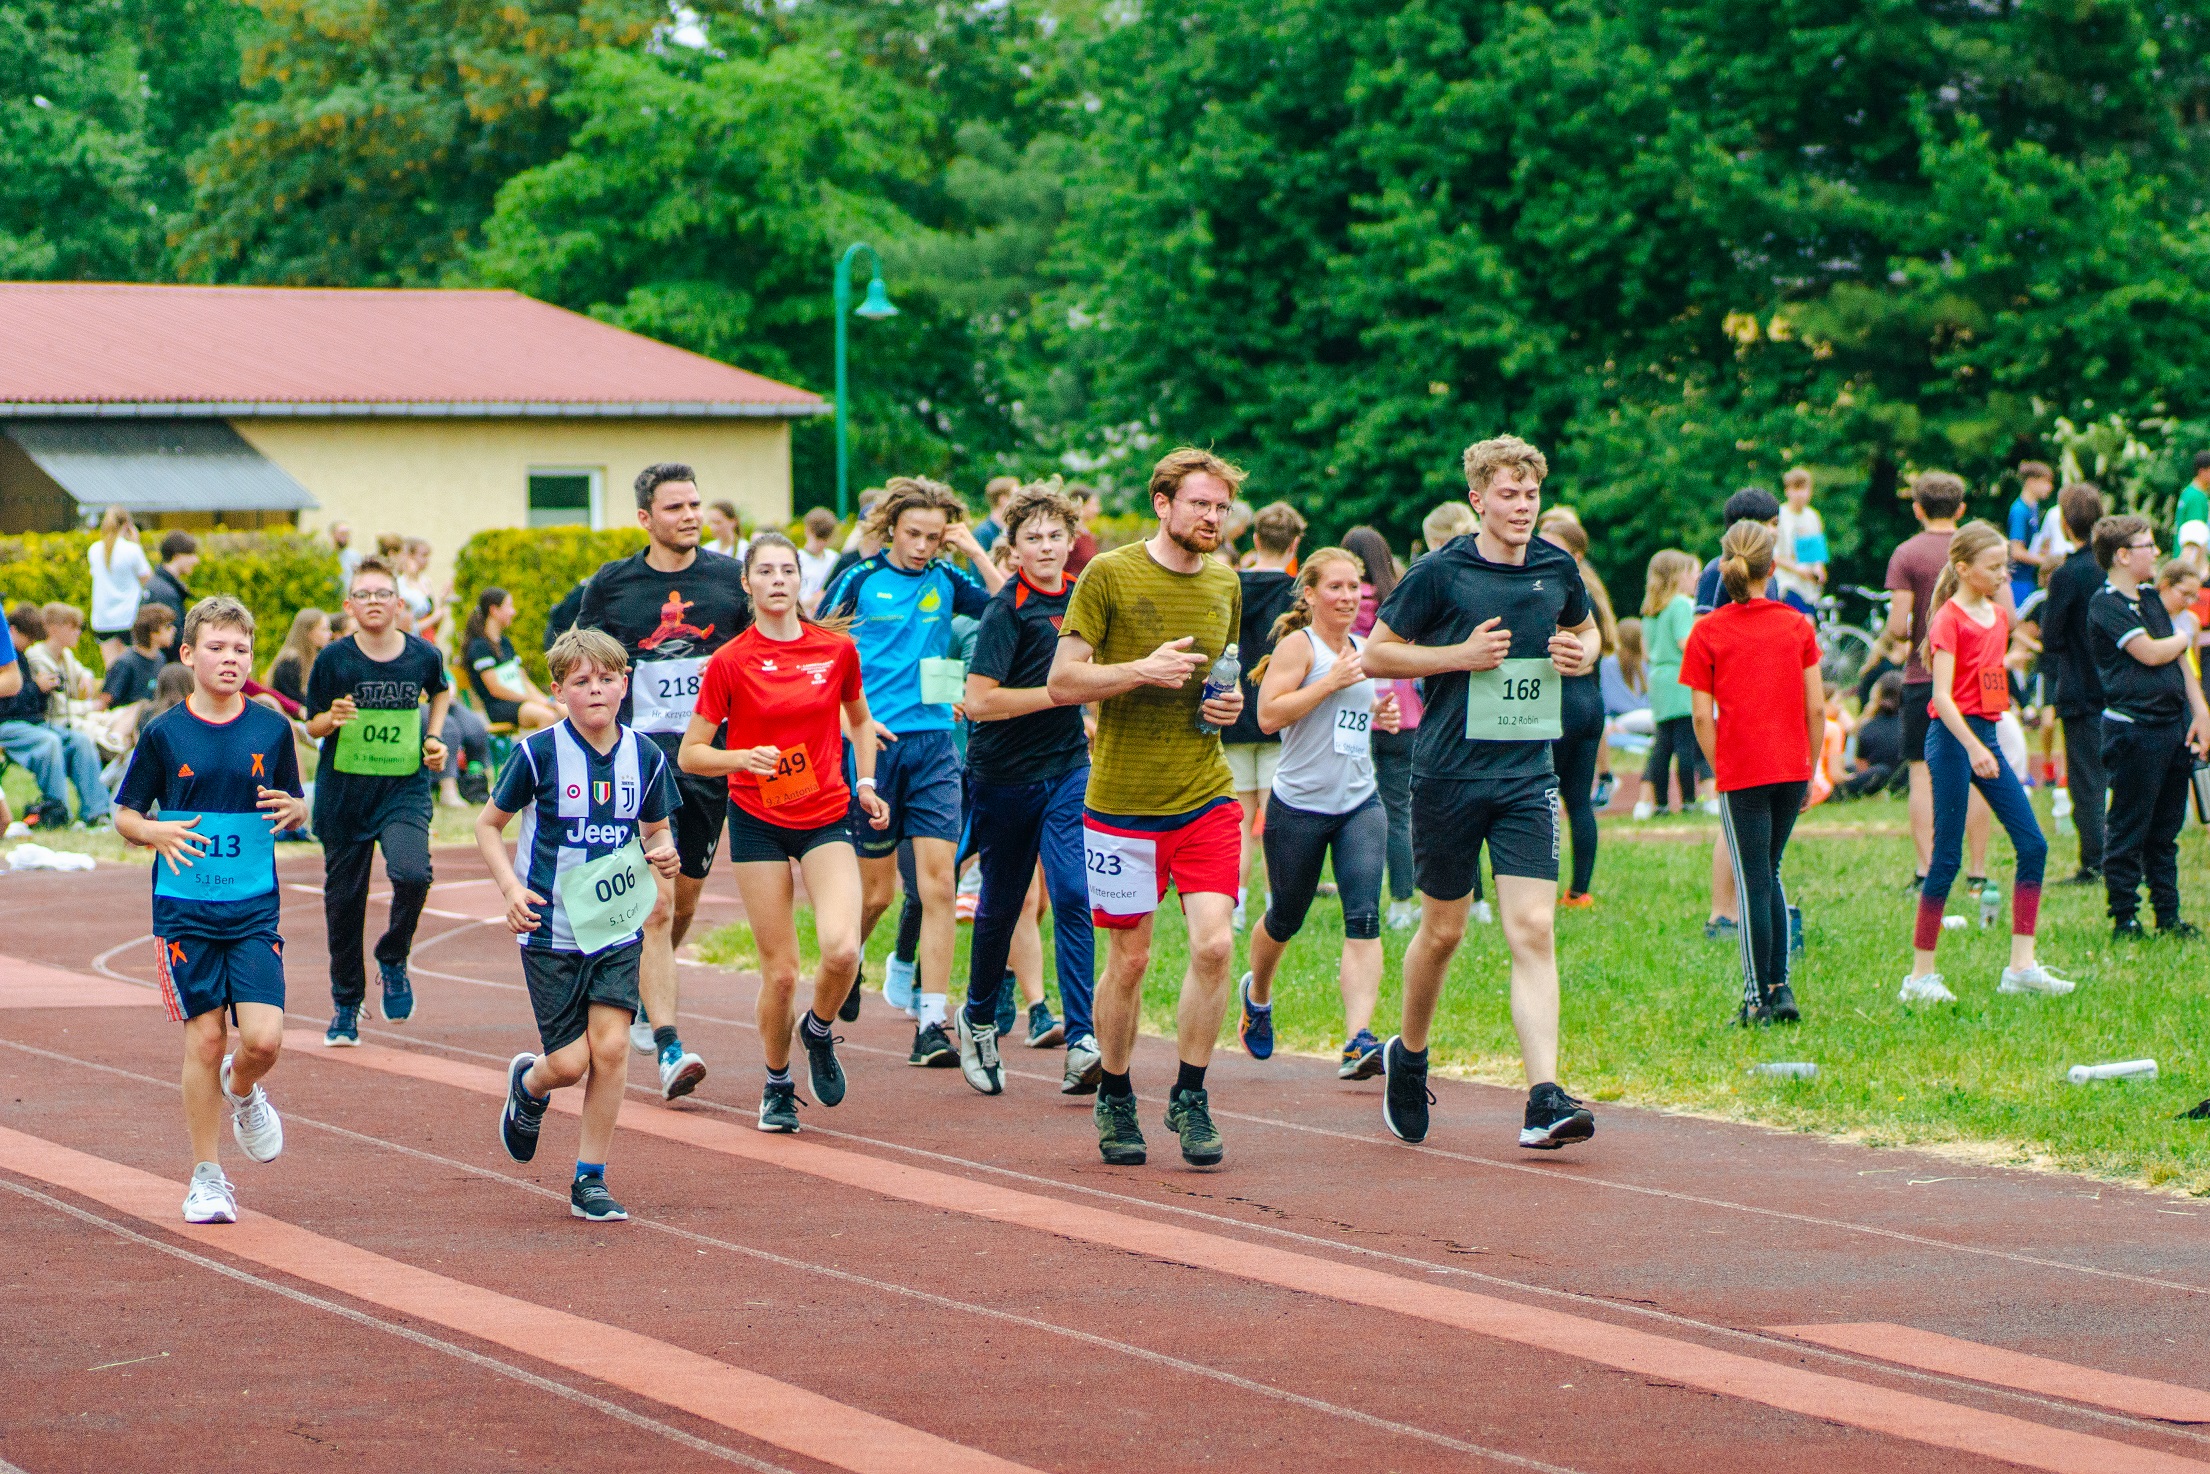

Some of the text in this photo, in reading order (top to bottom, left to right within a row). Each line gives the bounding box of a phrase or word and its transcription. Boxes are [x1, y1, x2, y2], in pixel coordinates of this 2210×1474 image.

[353, 681, 418, 701] STAR
[658, 676, 700, 698] 218
[1502, 678, 1541, 700] 168
[1983, 672, 2005, 690] 031
[1338, 709, 1368, 732] 228
[1497, 715, 1539, 725] 10.2 Robin
[363, 725, 401, 744] 042
[783, 784, 819, 802] Antonia
[566, 818, 629, 848] Jeep
[1086, 848, 1122, 876] 223
[195, 873, 235, 885] 5.1 Ben
[595, 864, 636, 903] 006
[609, 913, 625, 927] 5.1
